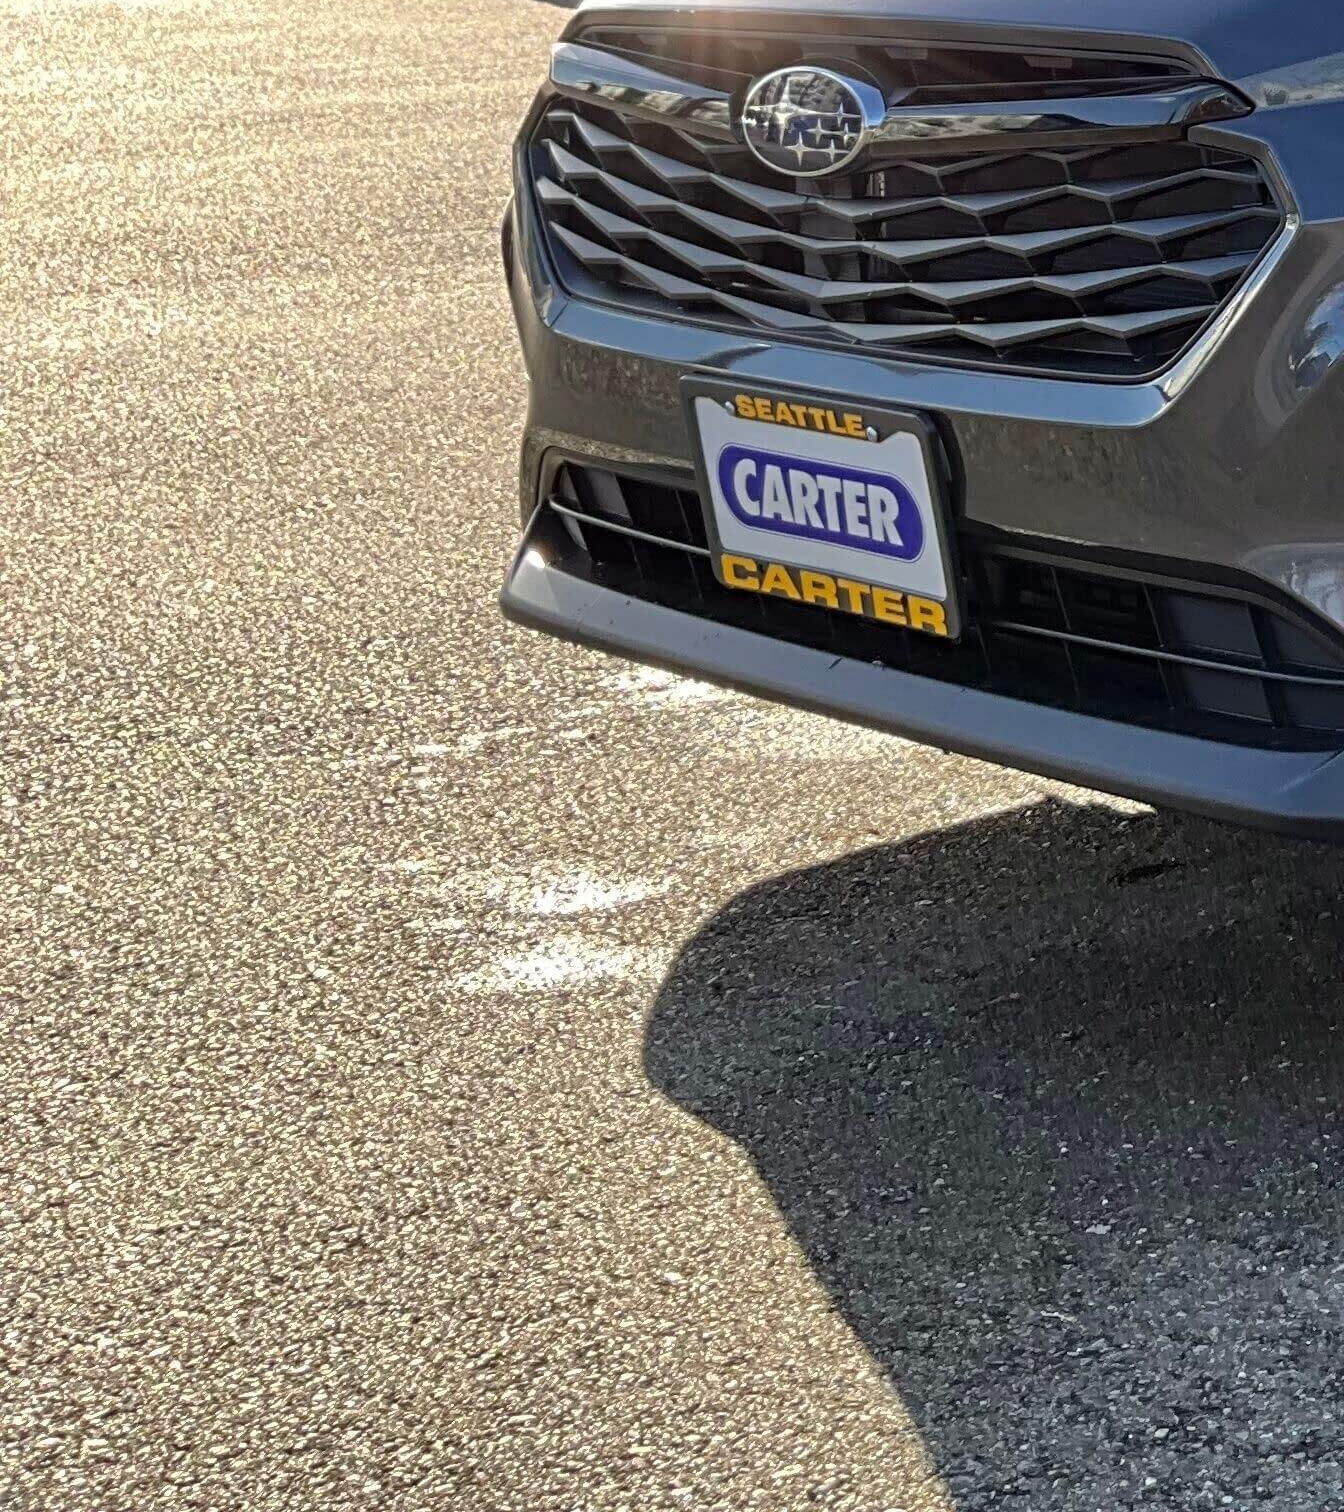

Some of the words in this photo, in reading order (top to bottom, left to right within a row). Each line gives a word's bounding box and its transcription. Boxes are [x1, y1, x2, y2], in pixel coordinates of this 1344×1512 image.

[734, 394, 867, 438] SEATTLE
[733, 458, 904, 547] CARTER
[720, 553, 948, 636] CARTER
